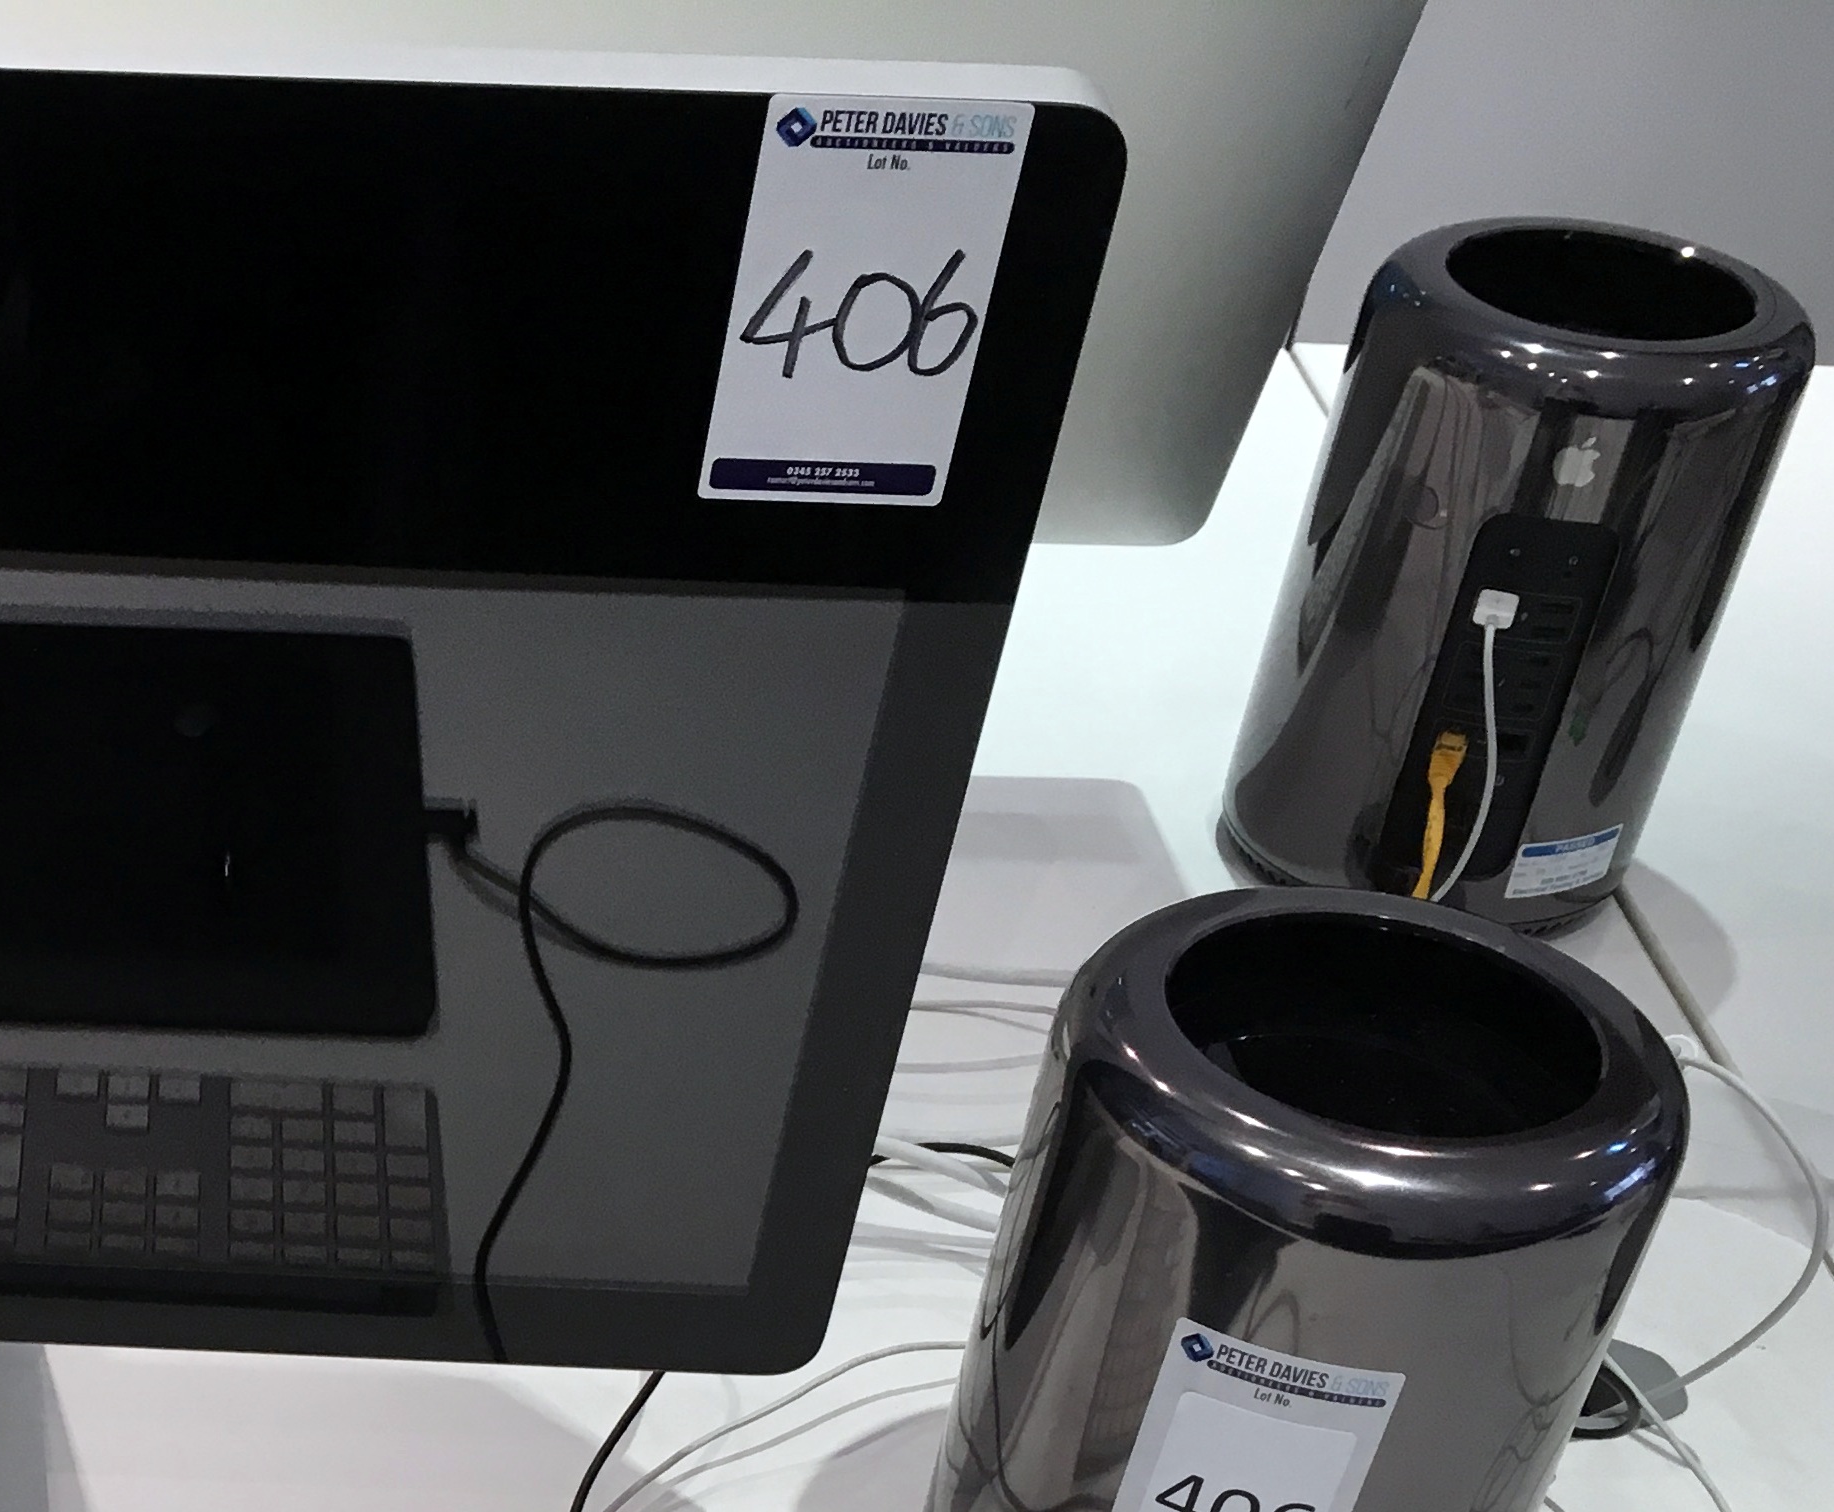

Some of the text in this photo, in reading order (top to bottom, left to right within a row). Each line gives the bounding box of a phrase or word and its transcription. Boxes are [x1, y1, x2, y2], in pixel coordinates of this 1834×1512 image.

[820, 110, 1017, 138] PETER DAVIES & SONS
[867, 154, 911, 171] Lot No.
[740, 249, 978, 379] 406
[1216, 1344, 1268, 1374] PETER
[1269, 1361, 1329, 1389] DAVIES
[1346, 1377, 1390, 1397] SONS
[1254, 1387, 1272, 1401] Lot
